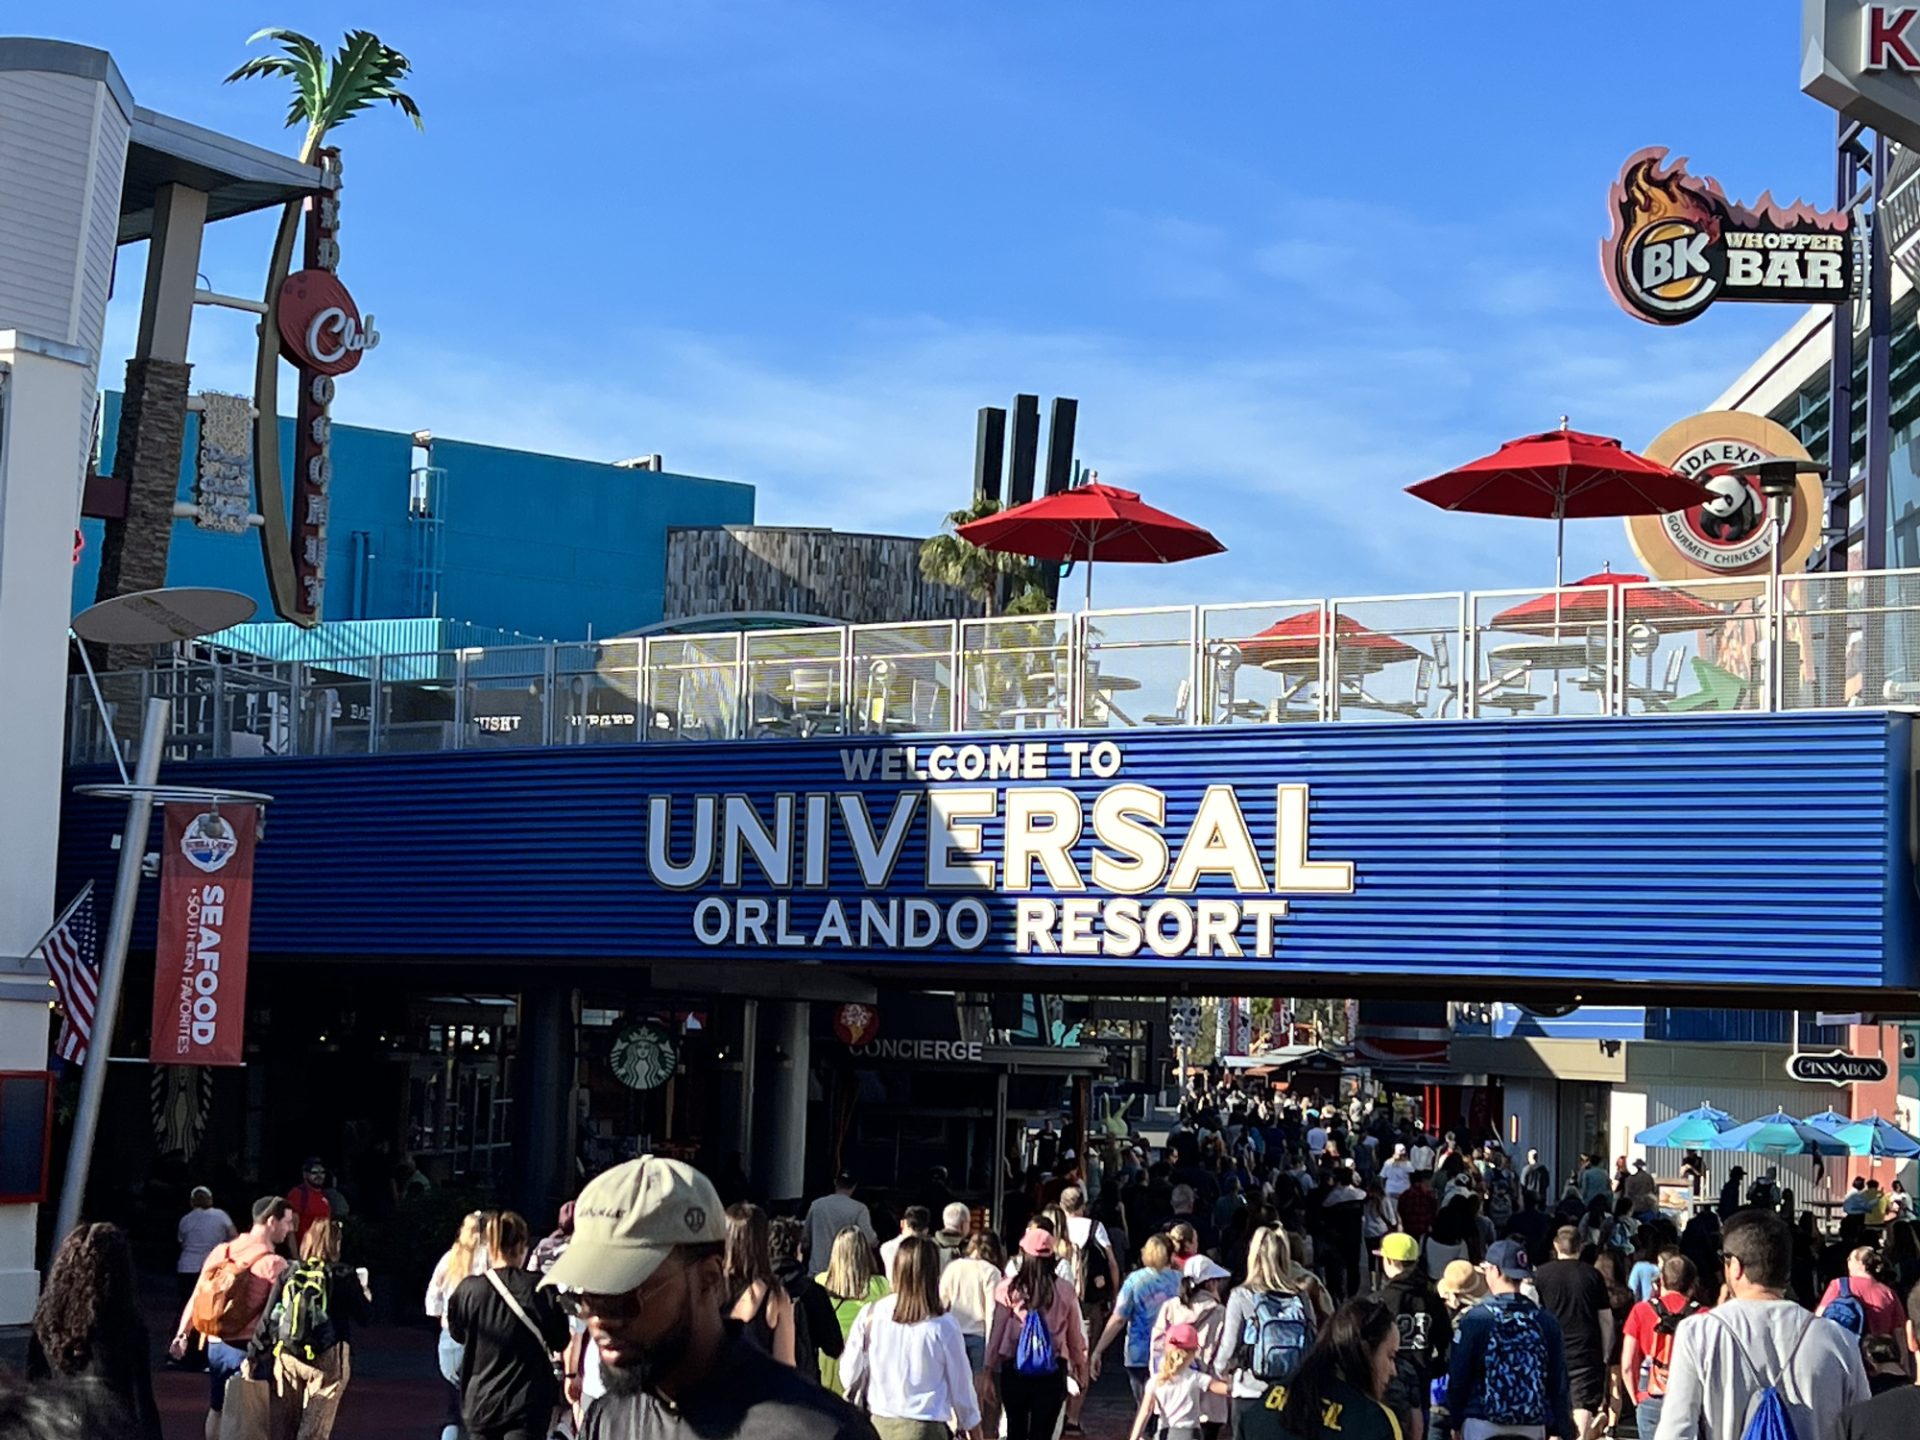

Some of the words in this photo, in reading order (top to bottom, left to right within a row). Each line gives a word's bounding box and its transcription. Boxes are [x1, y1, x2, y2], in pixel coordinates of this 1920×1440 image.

[1643, 232, 1710, 289] BK
[1725, 232, 1844, 251] WHOPPER
[1726, 250, 1844, 289] BAR
[306, 307, 380, 363] Club
[1680, 449, 1716, 477] NDA
[1667, 514, 1709, 560] GOURMET
[1714, 545, 1763, 564] CHINESE
[840, 743, 1047, 783] WELCOME
[1064, 741, 1122, 778] TO
[646, 783, 1356, 895] UNIVERSAL
[184, 895, 200, 974] SOUTHERN
[692, 897, 990, 951] ORLANDO
[1015, 899, 1289, 958] RESORT
[191, 884, 225, 1045] SEAFOOD
[177, 977, 194, 1055] FAVORITES
[1798, 1059, 1881, 1077] CINNABON
